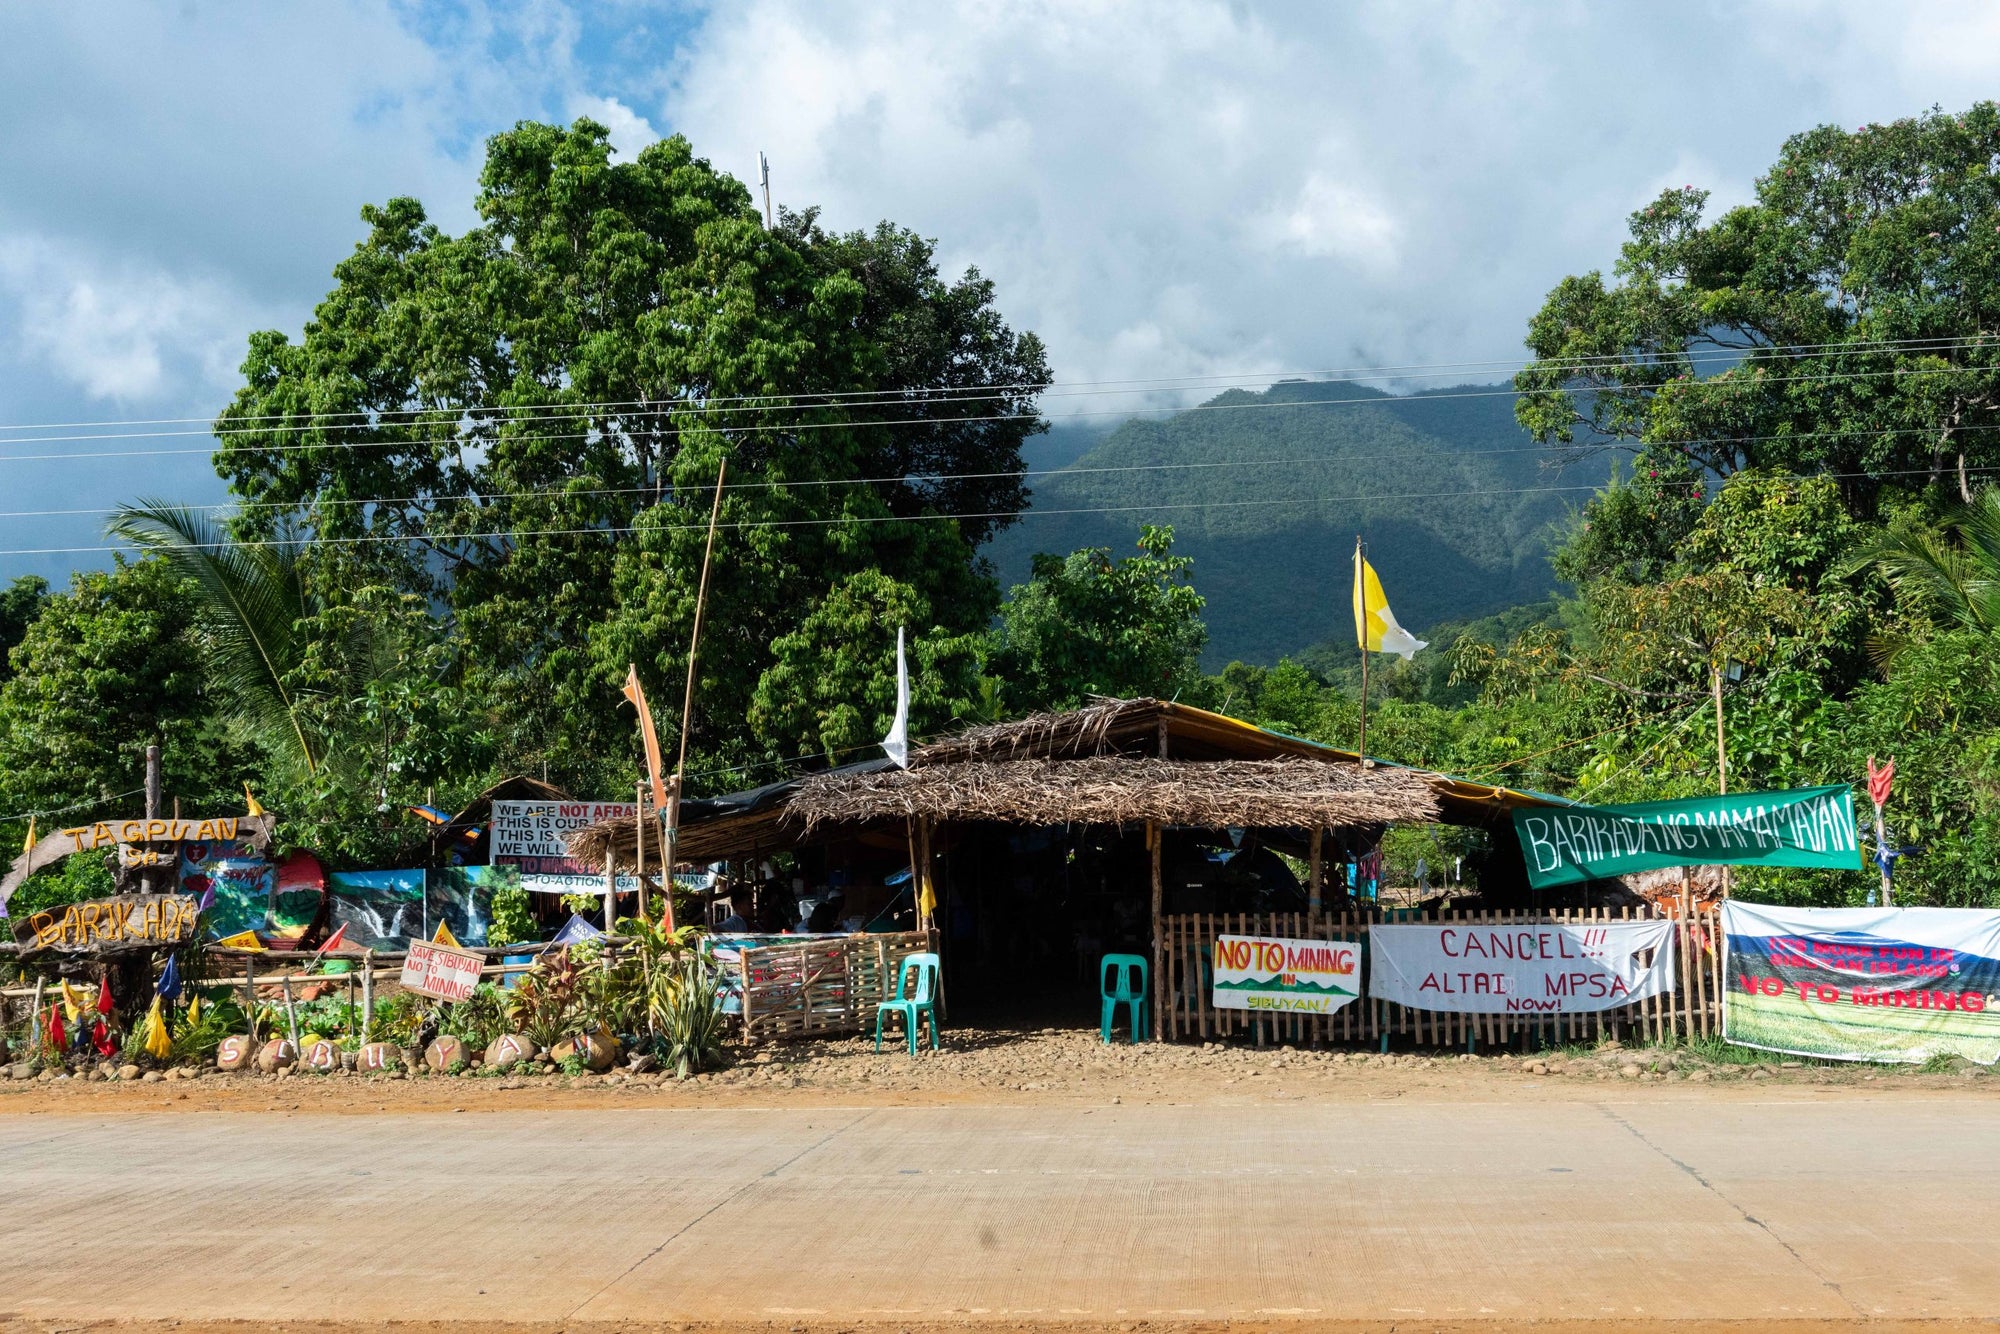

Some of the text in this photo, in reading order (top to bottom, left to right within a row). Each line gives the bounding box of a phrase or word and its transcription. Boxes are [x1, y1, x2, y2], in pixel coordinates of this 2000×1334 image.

[498, 805, 521, 816] WE
[525, 806, 556, 817] ARE
[559, 805, 589, 817] NOT
[498, 816, 532, 829] THIS
[536, 818, 550, 829] IS
[555, 818, 589, 829] OUR
[62, 817, 239, 851] TAGPUAN
[498, 829, 534, 841] THIS
[540, 830, 554, 841] IS
[1525, 794, 1856, 873] BARIKADA NG MAMAMAYAN
[498, 843, 564, 855] WE WILL
[521, 857, 538, 873] TO
[30, 899, 195, 949] BARIKADA
[1215, 939, 1355, 976] NO TO MINING
[1813, 941, 1873, 958] MORE
[1879, 946, 1924, 961] FUN
[1931, 947, 1954, 962] IN
[407, 959, 438, 975] NO TO
[409, 946, 483, 977] SAVE SIBUYAN
[1870, 961, 1950, 978] ISLAND
[422, 974, 472, 1000] MINING
[1281, 972, 1296, 985] IN
[1419, 972, 1629, 999] ALTAI MPSA
[1738, 974, 1985, 1013] NO TO MINING
[1506, 997, 1562, 1012] NOW!
